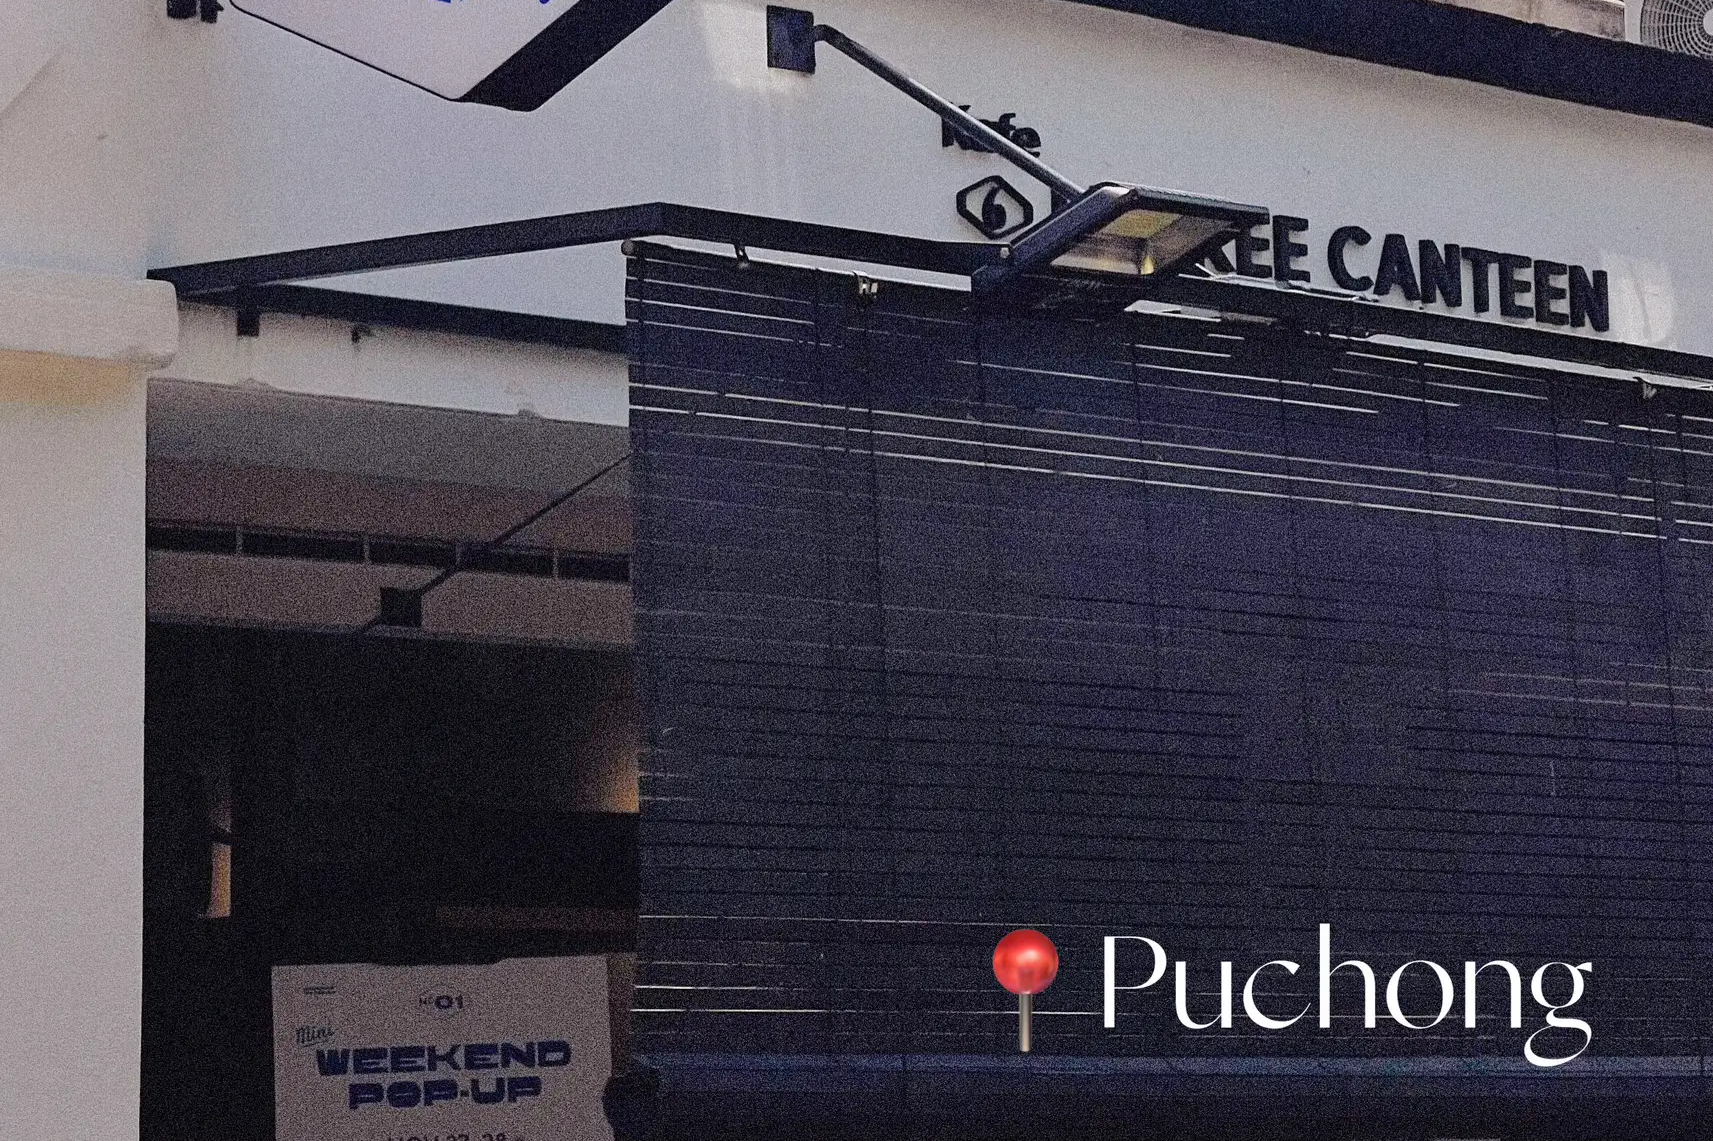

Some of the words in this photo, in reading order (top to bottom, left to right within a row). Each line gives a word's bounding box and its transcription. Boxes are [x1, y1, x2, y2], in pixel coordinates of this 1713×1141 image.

[1327, 226, 1610, 333] CANTEEN
[316, 1040, 572, 1076] WEEKEND
[349, 1075, 542, 1110] POP-UP
